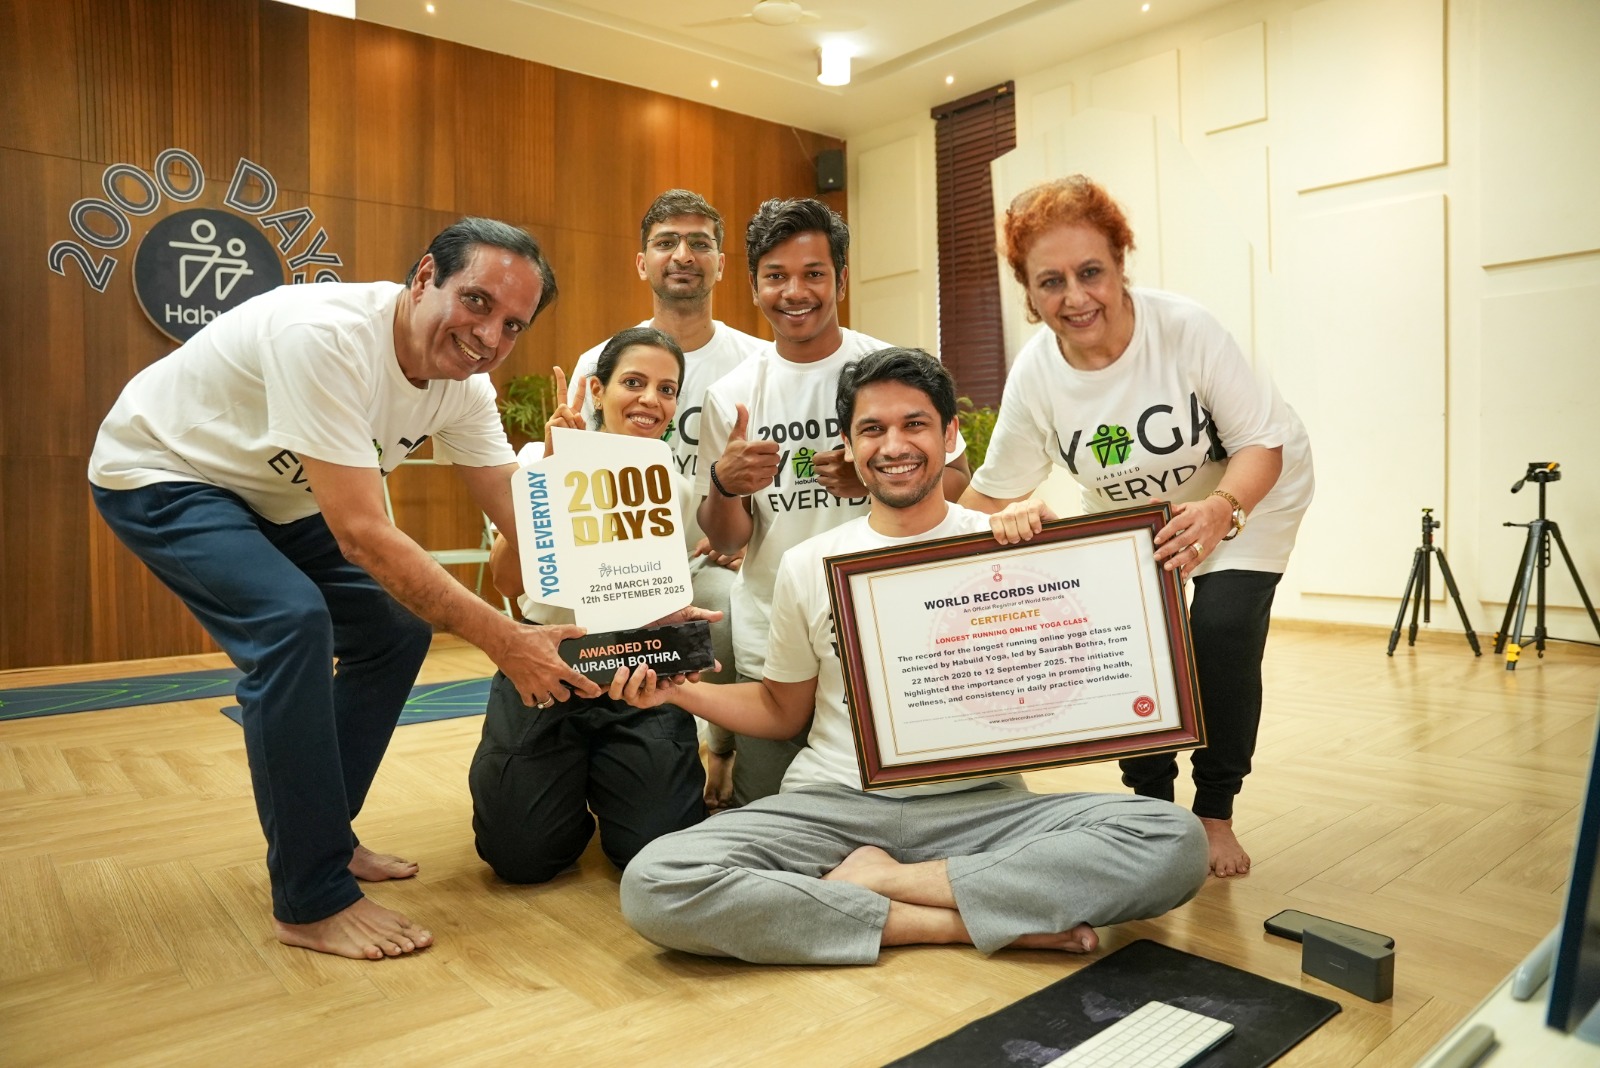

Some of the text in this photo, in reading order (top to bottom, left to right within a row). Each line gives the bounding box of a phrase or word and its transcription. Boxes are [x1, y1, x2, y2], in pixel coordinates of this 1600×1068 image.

[48, 148, 205, 293] 2000
[758, 418, 820, 444] 2000
[564, 464, 672, 513] 2000
[1096, 466, 1140, 482] HABUILD
[1096, 462, 1205, 502] ERYD
[768, 488, 872, 512] EVER
[527, 471, 560, 597] YOGA EVERYDAY
[571, 507, 675, 546] DAYS
[613, 560, 661, 576] Habuild
[581, 584, 685, 604] 12th SEPTEMBER 2025
[590, 576, 673, 593] 22nd MARCH 2020
[924, 578, 1081, 610] WORLD RECORDS UNION
[970, 608, 1041, 626] CERTIFICATE
[972, 604, 992, 612] Official
[992, 601, 1017, 610] Registrar
[1042, 594, 1064, 602] Records
[915, 650, 941, 660] record
[957, 647, 971, 655] the
[973, 641, 1004, 652] longest
[1006, 637, 1037, 648] running
[1039, 633, 1064, 642] online
[1067, 630, 1087, 640] yoga
[1089, 626, 1112, 636] class
[935, 617, 1088, 644] LONGEST RUNNING ONLINE YOGA CLASS
[572, 650, 681, 674] AURABH BOTHRA
[579, 638, 662, 659] AWARDED TO
[901, 635, 1128, 674] achieved by Habuild Yoga, led by Saurabh Bothra, from
[904, 685, 949, 698] highlighted
[967, 676, 1014, 688] importance
[1026, 673, 1046, 682] yoga
[1058, 664, 1101, 677] promoting
[1103, 660, 1133, 670] health,
[924, 674, 949, 683] March
[951, 671, 972, 680] 2020
[985, 667, 995, 675] 12
[997, 661, 1041, 674] September
[1044, 658, 1067, 667] 2025.
[1069, 655, 1085, 663] The
[1087, 649, 1125, 661] initiative
[907, 697, 946, 708] wellness,
[948, 695, 963, 703] and
[965, 688, 1015, 701] consistency
[1027, 682, 1047, 692] daily
[1049, 678, 1084, 690] practice
[1086, 672, 1133, 684] worldwide.
